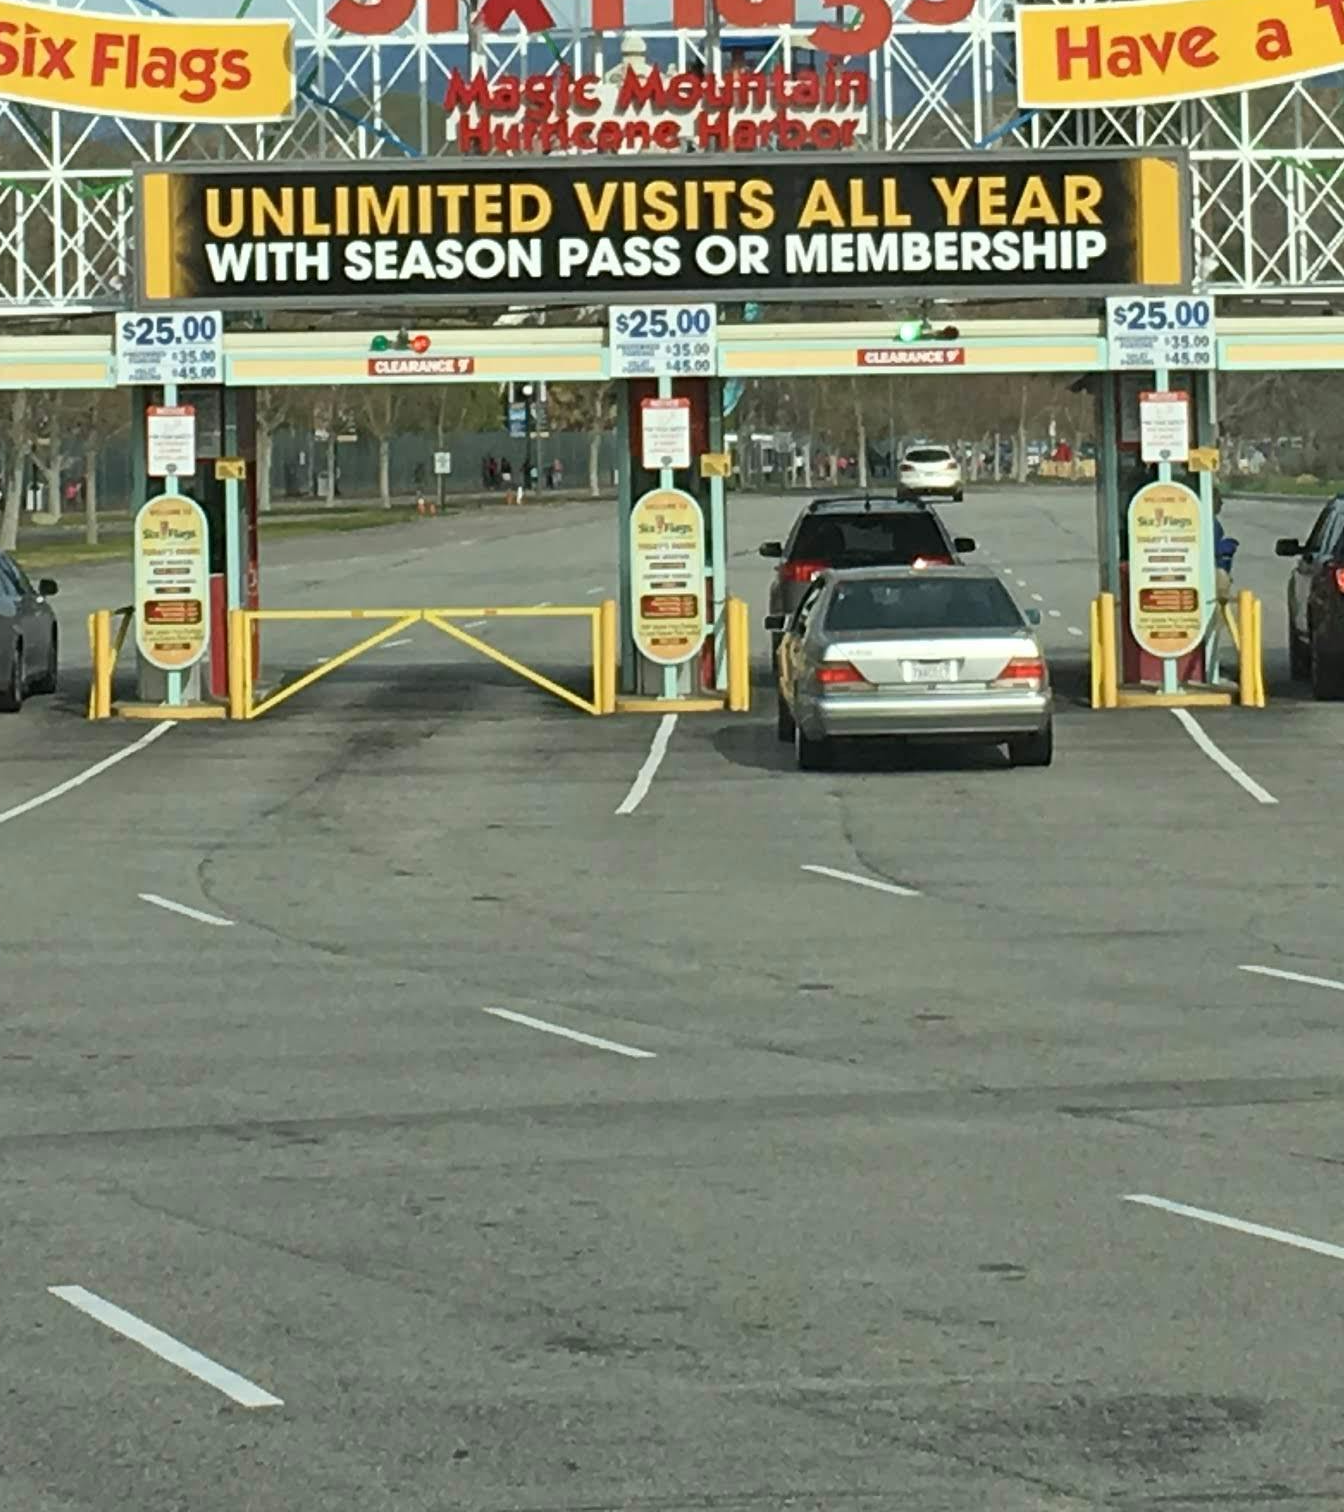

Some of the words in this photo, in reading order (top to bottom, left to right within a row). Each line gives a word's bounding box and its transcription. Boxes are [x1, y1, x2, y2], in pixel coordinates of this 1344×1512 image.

[91, 33, 251, 103] Flags
[1056, 23, 1220, 80] Have
[1256, 19, 1291, 61] a
[444, 62, 602, 123] Magic
[617, 59, 870, 113] Mountain
[459, 113, 683, 155] Hurricane
[695, 110, 858, 152] Harbor
[205, 181, 552, 238] UNLIMITED
[573, 178, 776, 233] VISITS
[799, 177, 911, 230] ALL
[934, 174, 1102, 227] YEAR
[205, 243, 330, 283] WITH
[343, 239, 548, 282] SEASON
[558, 236, 682, 279] PASS
[695, 234, 771, 276] OR
[784, 229, 1109, 274] MEMBERSHIP
[123, 316, 216, 345] $25.00
[616, 309, 710, 337] $25.00
[1114, 301, 1209, 329] $25.00
[375, 360, 455, 374] CLEARANCE
[864, 351, 944, 364] CLEARANCE
